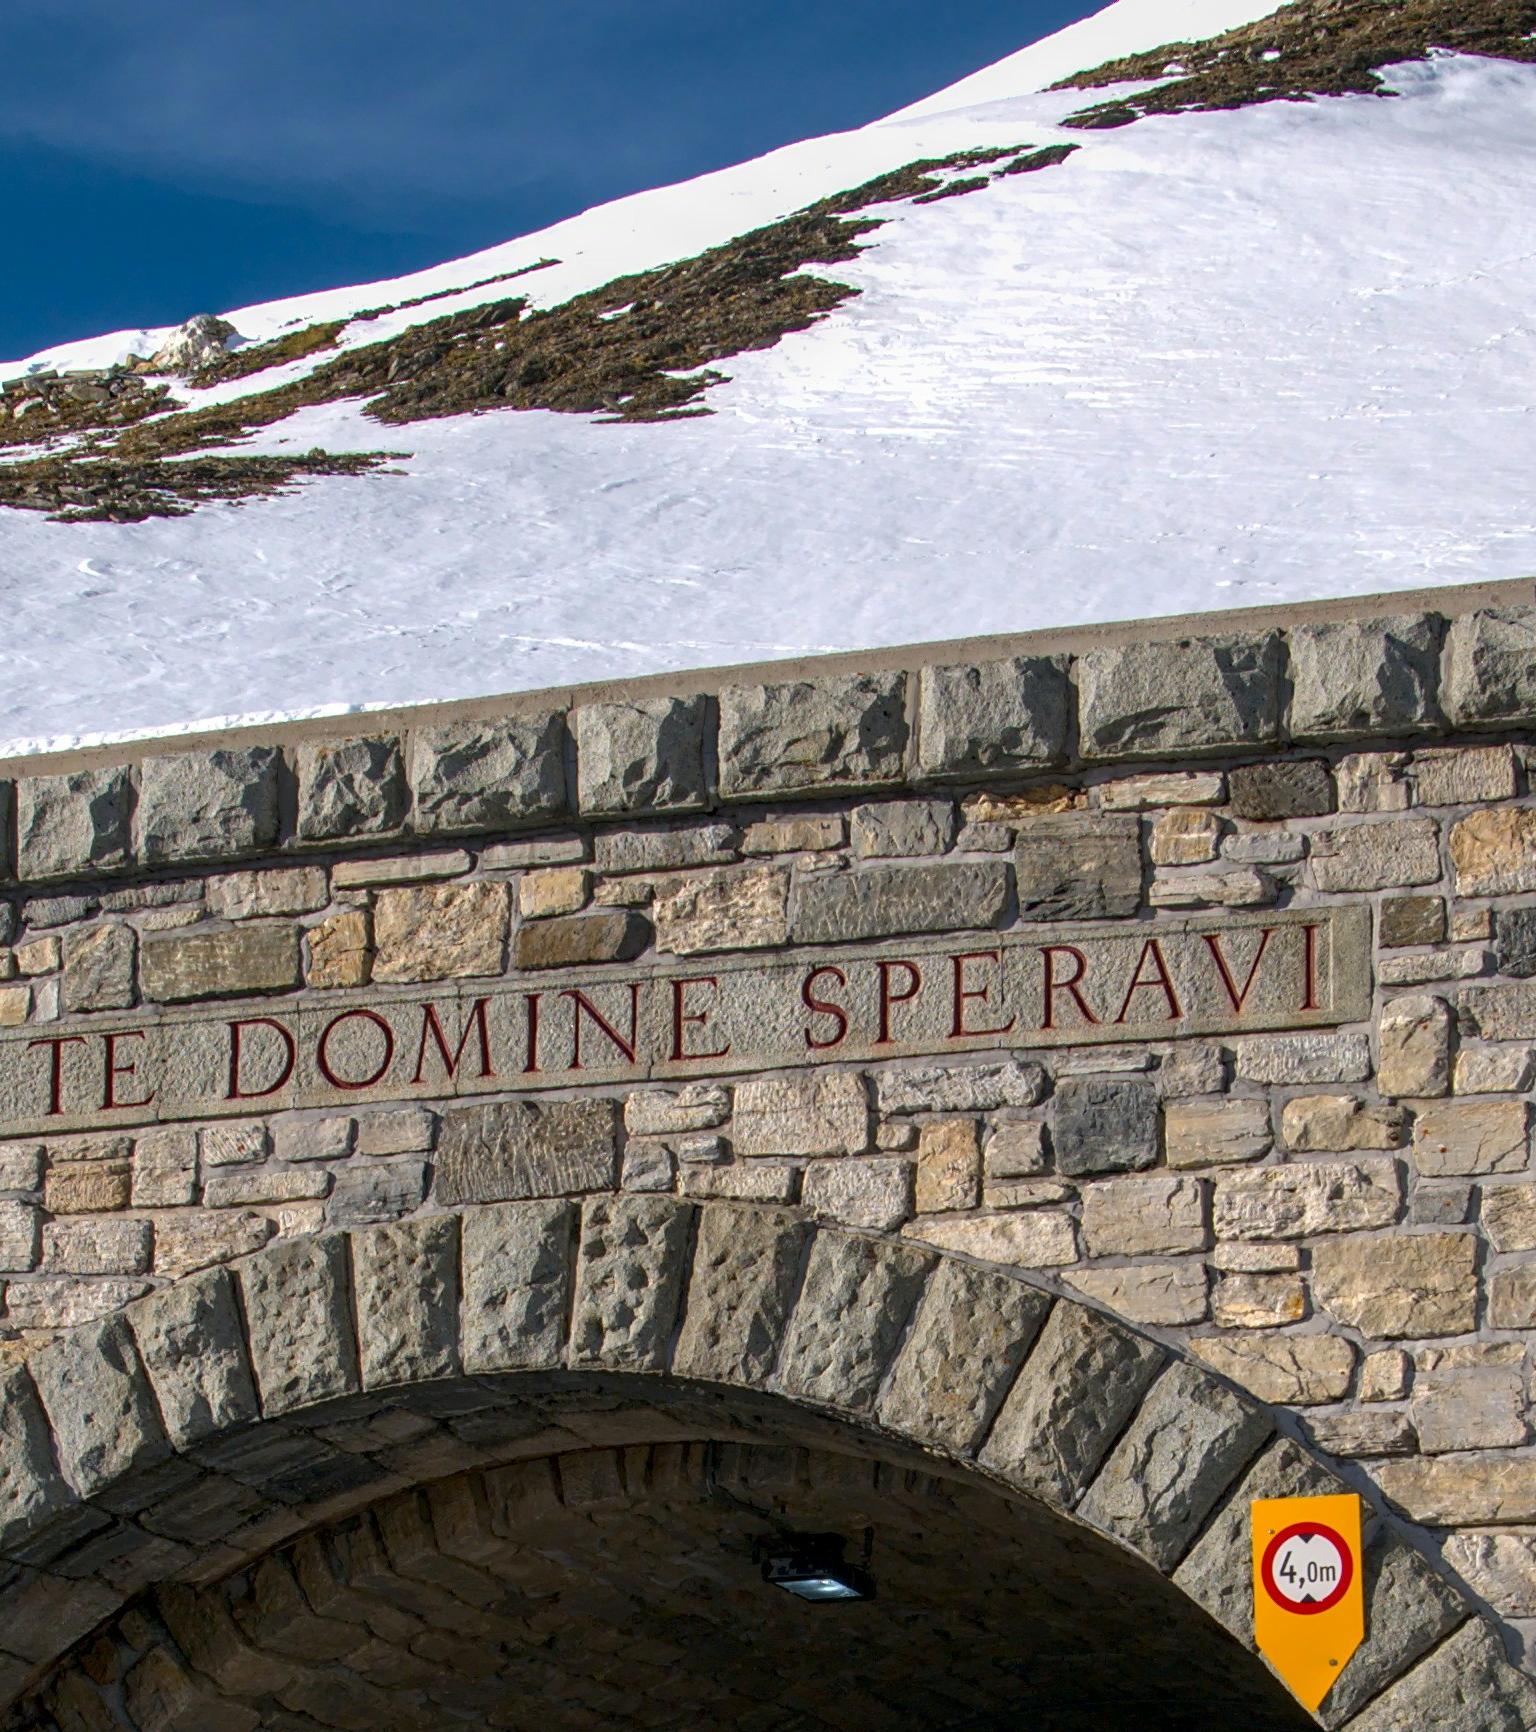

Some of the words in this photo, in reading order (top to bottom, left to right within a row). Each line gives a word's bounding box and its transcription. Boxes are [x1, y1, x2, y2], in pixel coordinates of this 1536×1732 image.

[27, 1030, 158, 1116] TE
[223, 976, 732, 1100] DOMINE
[801, 923, 1320, 1050] SPERAVI
[1278, 1550, 1337, 1589] 4,0m
